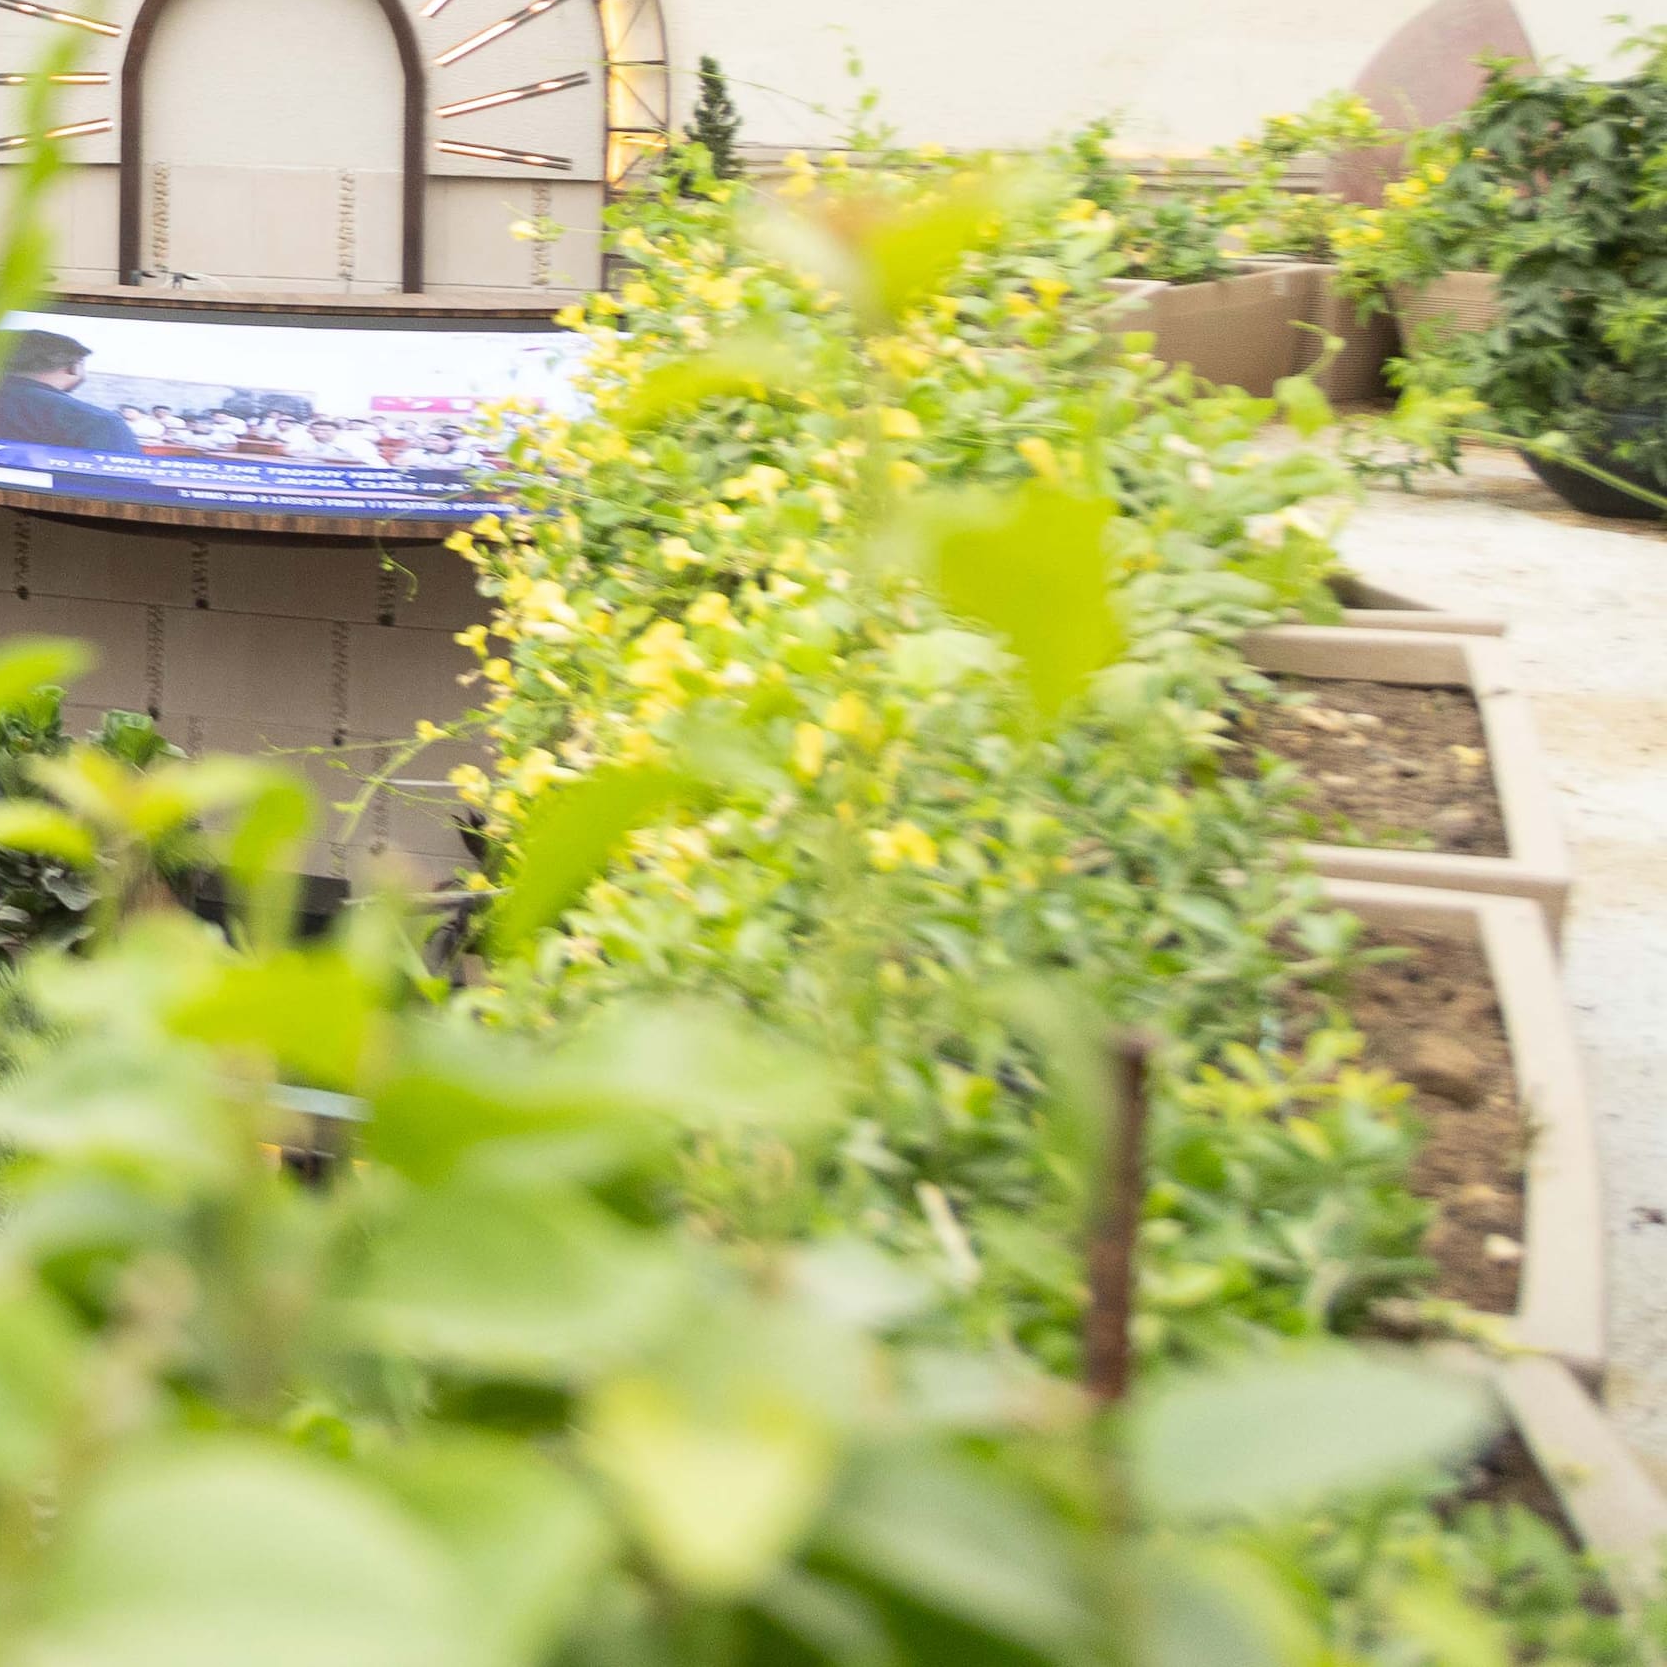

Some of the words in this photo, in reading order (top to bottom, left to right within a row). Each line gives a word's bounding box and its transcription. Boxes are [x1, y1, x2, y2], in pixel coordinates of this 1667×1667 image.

[48, 458, 71, 466] TO
[102, 464, 182, 477] XAVIER'S
[353, 481, 418, 490] CLASS
[109, 455, 153, 466] WILL
[158, 460, 219, 471] BRING
[223, 464, 261, 474] THE
[266, 466, 346, 478] TROPHY
[191, 490, 229, 501] WINS
[229, 494, 258, 503] AND
[270, 495, 324, 506] LOSSES
[324, 499, 365, 508] FROM
[386, 502, 452, 511] MATCHES
